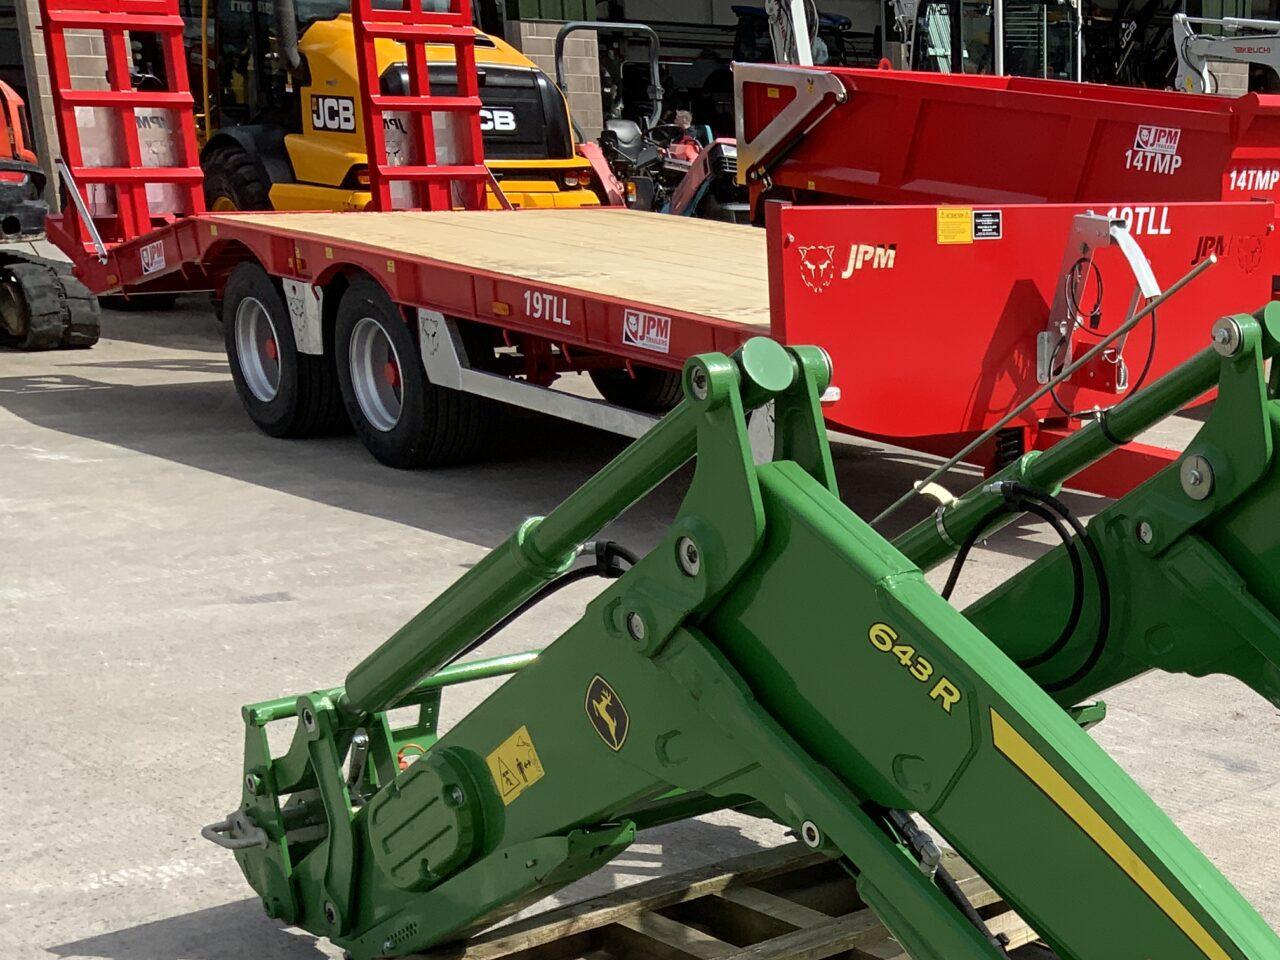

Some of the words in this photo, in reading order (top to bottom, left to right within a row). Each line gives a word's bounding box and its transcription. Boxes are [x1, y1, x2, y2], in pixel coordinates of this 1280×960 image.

[312, 97, 356, 130] JCB
[479, 108, 516, 131] CB
[1150, 128, 1178, 148] JPM
[1125, 149, 1182, 175] 14TMP
[1229, 169, 1280, 191] 14TMP
[841, 243, 897, 279] JPM
[524, 290, 571, 326] 19TLL
[638, 314, 670, 341] JPM
[868, 622, 934, 683] 643
[927, 675, 962, 716] R
